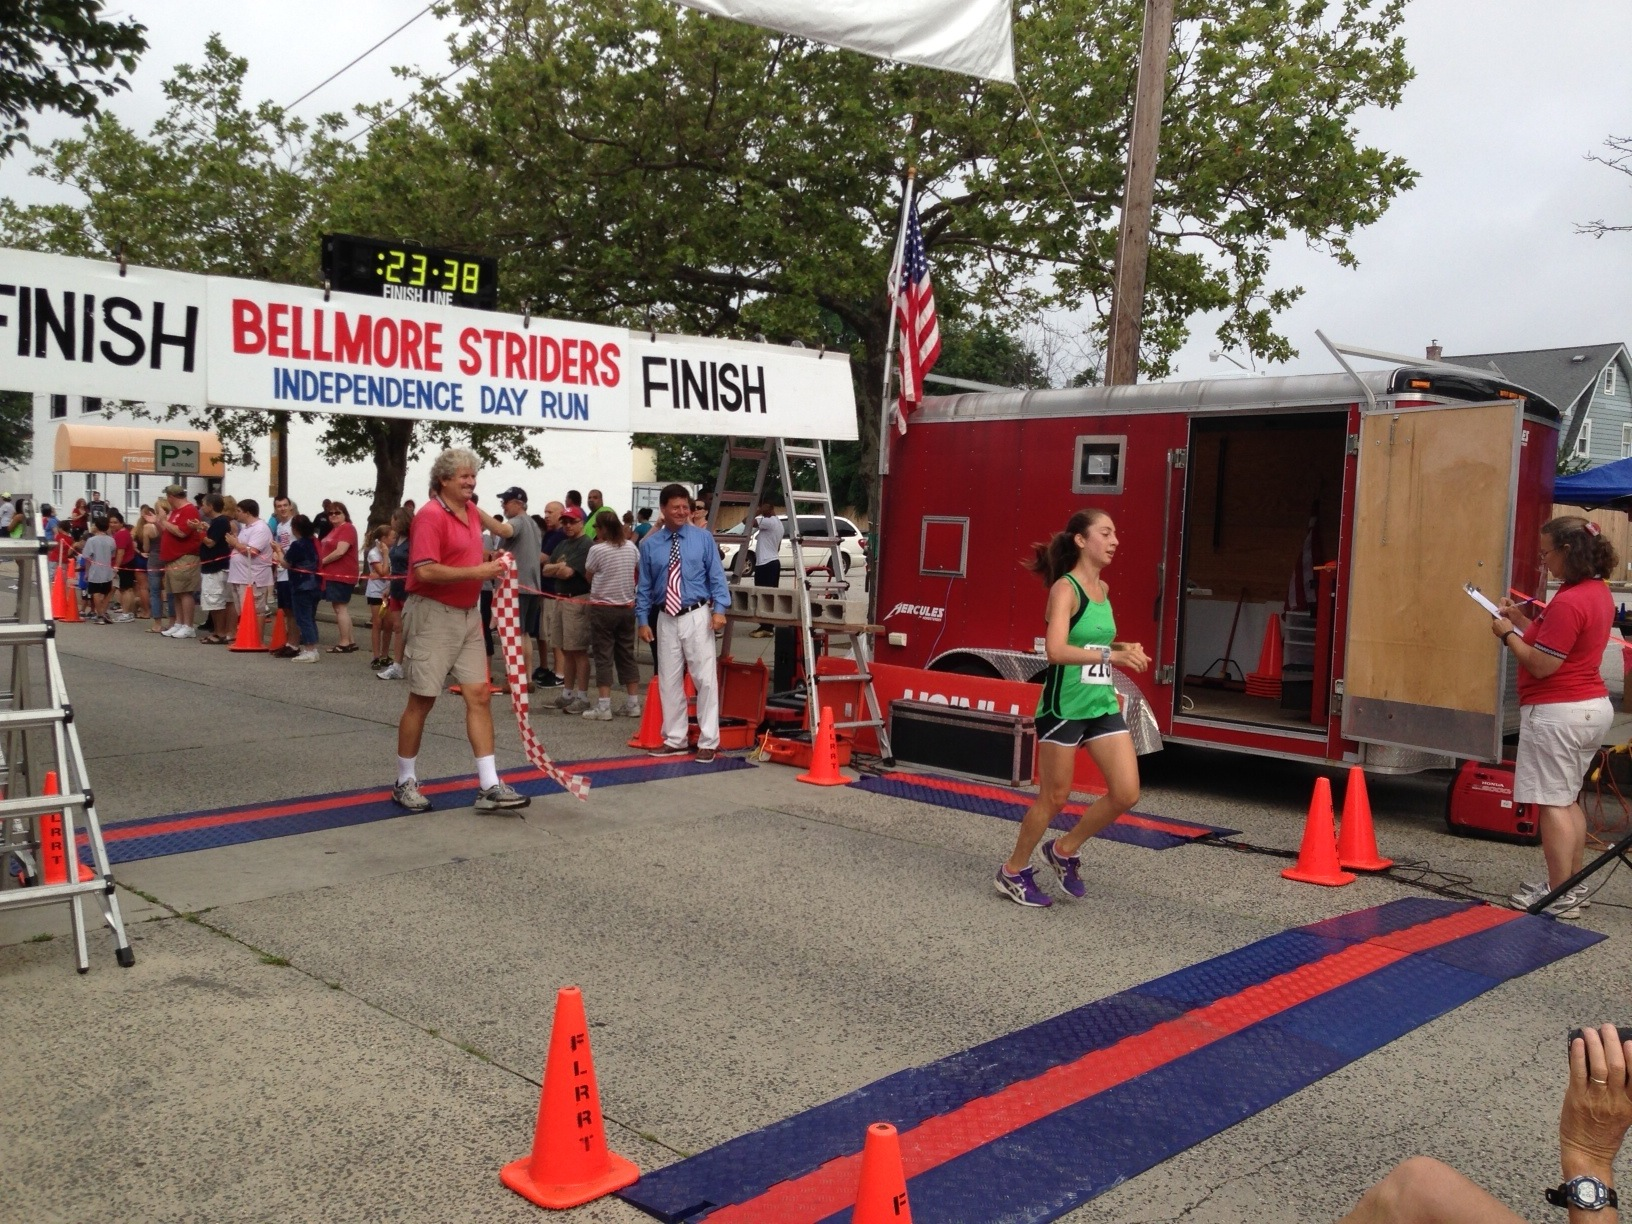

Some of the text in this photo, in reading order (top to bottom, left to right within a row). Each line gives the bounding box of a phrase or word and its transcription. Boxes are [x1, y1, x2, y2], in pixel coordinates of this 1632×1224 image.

[382, 283, 453, 306] FINISH LINE
[232, 298, 621, 388] BELLMORE STRIDERS
[273, 367, 589, 421] INDEPENDENCE DAY RUN
[642, 356, 767, 414] FINISH
[883, 602, 944, 621] HERCULES
[50, 814, 63, 865] LRRT
[570, 1033, 594, 1152] FLRRT
